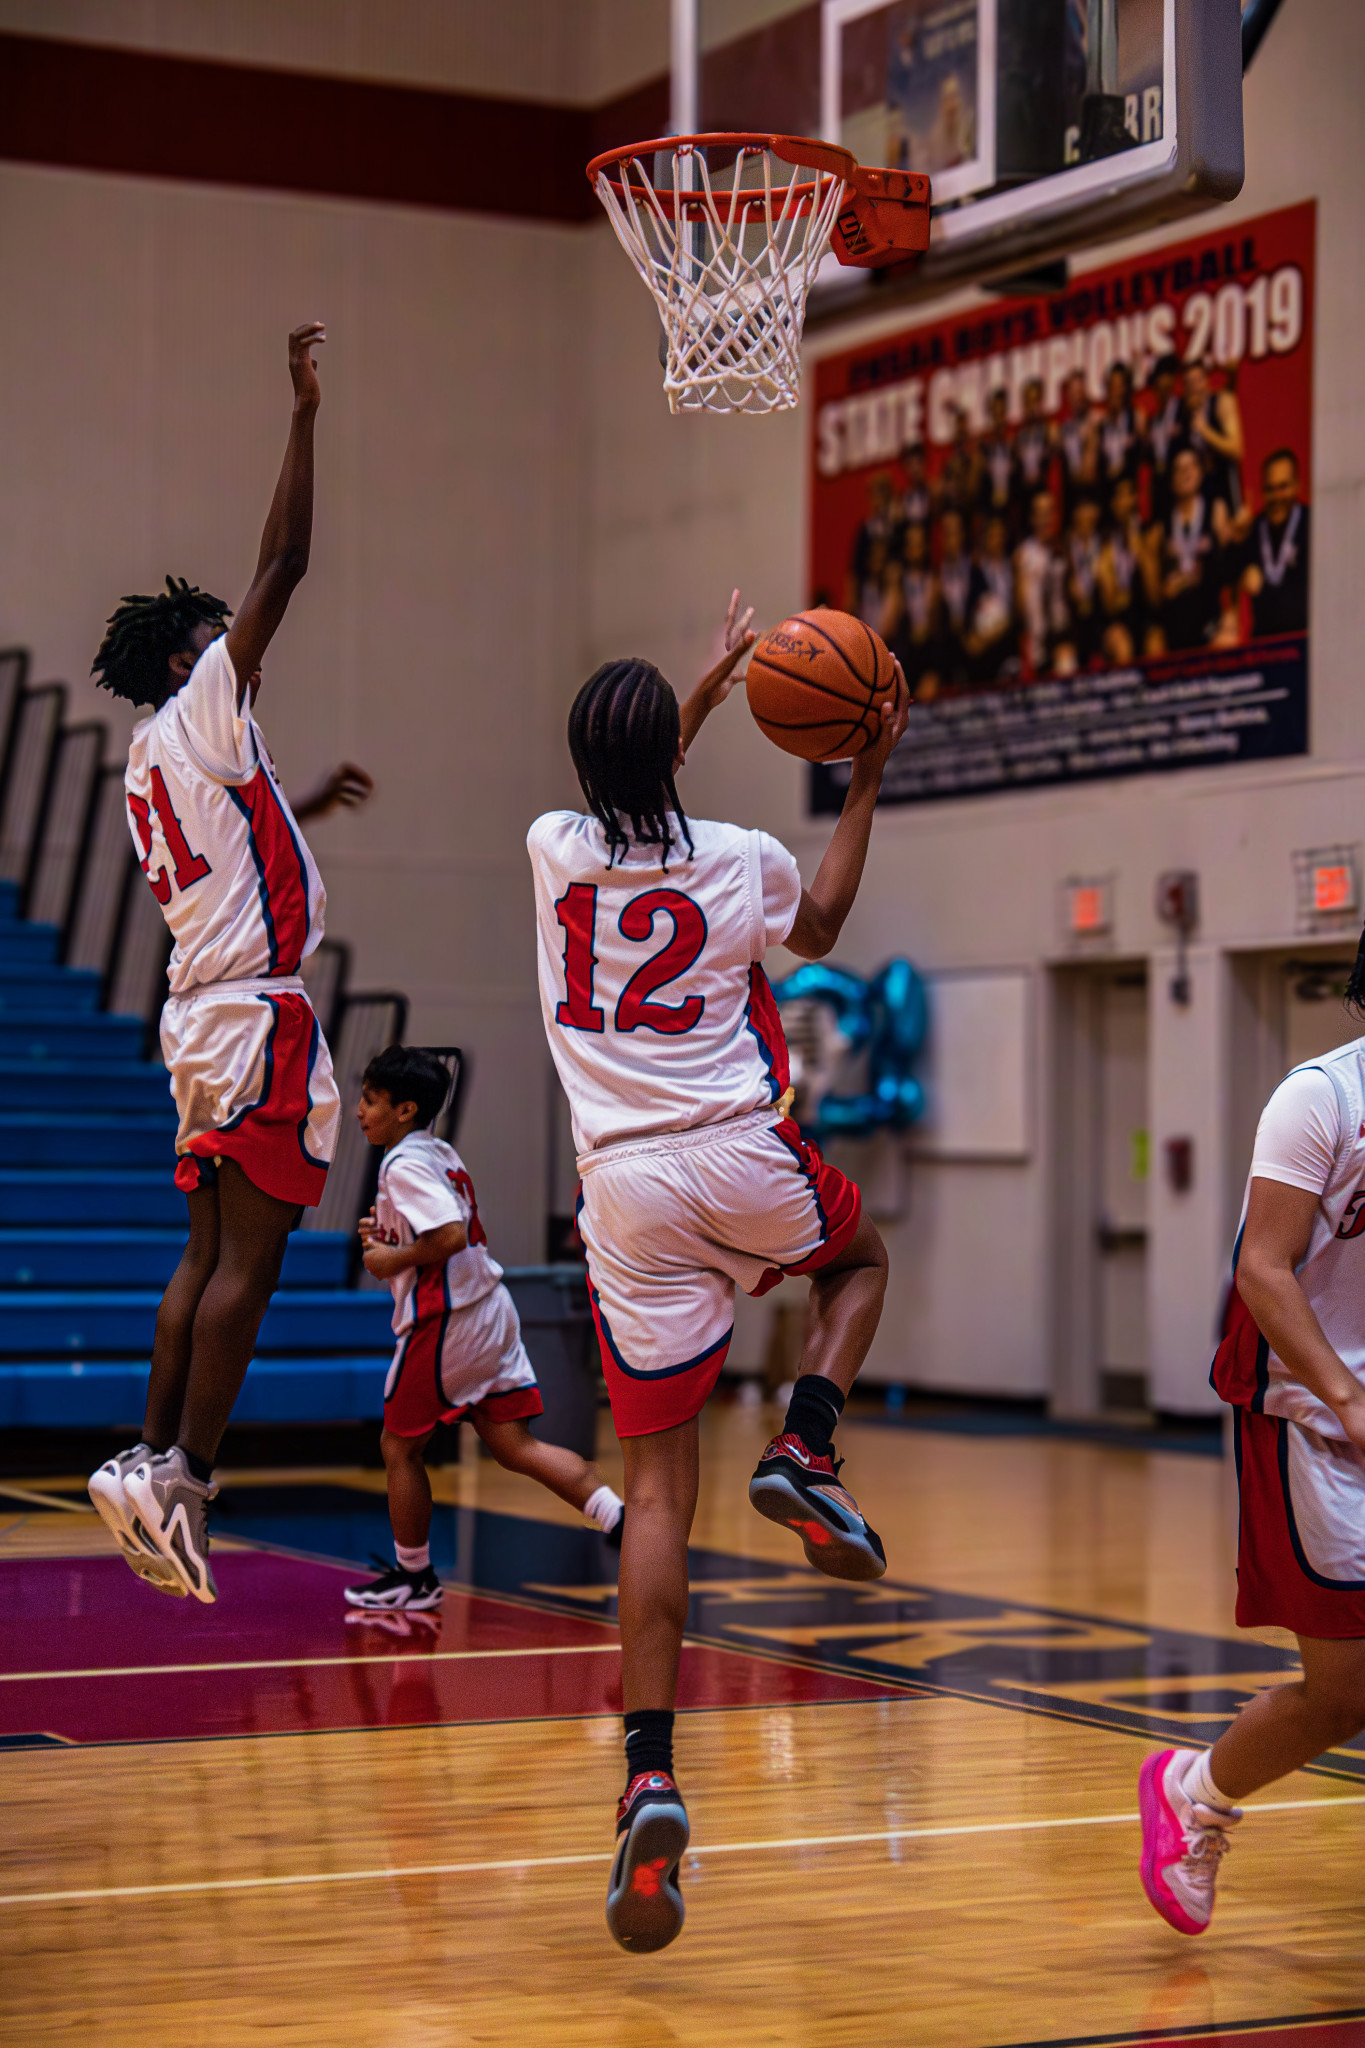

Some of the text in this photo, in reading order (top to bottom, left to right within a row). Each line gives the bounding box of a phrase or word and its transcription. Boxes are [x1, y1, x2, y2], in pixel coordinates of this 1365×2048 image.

[1050, 237, 1257, 328] VOLLEYBALL
[818, 378, 924, 477] STATE
[1183, 265, 1303, 367] 2019
[554, 882, 708, 1035] 12
